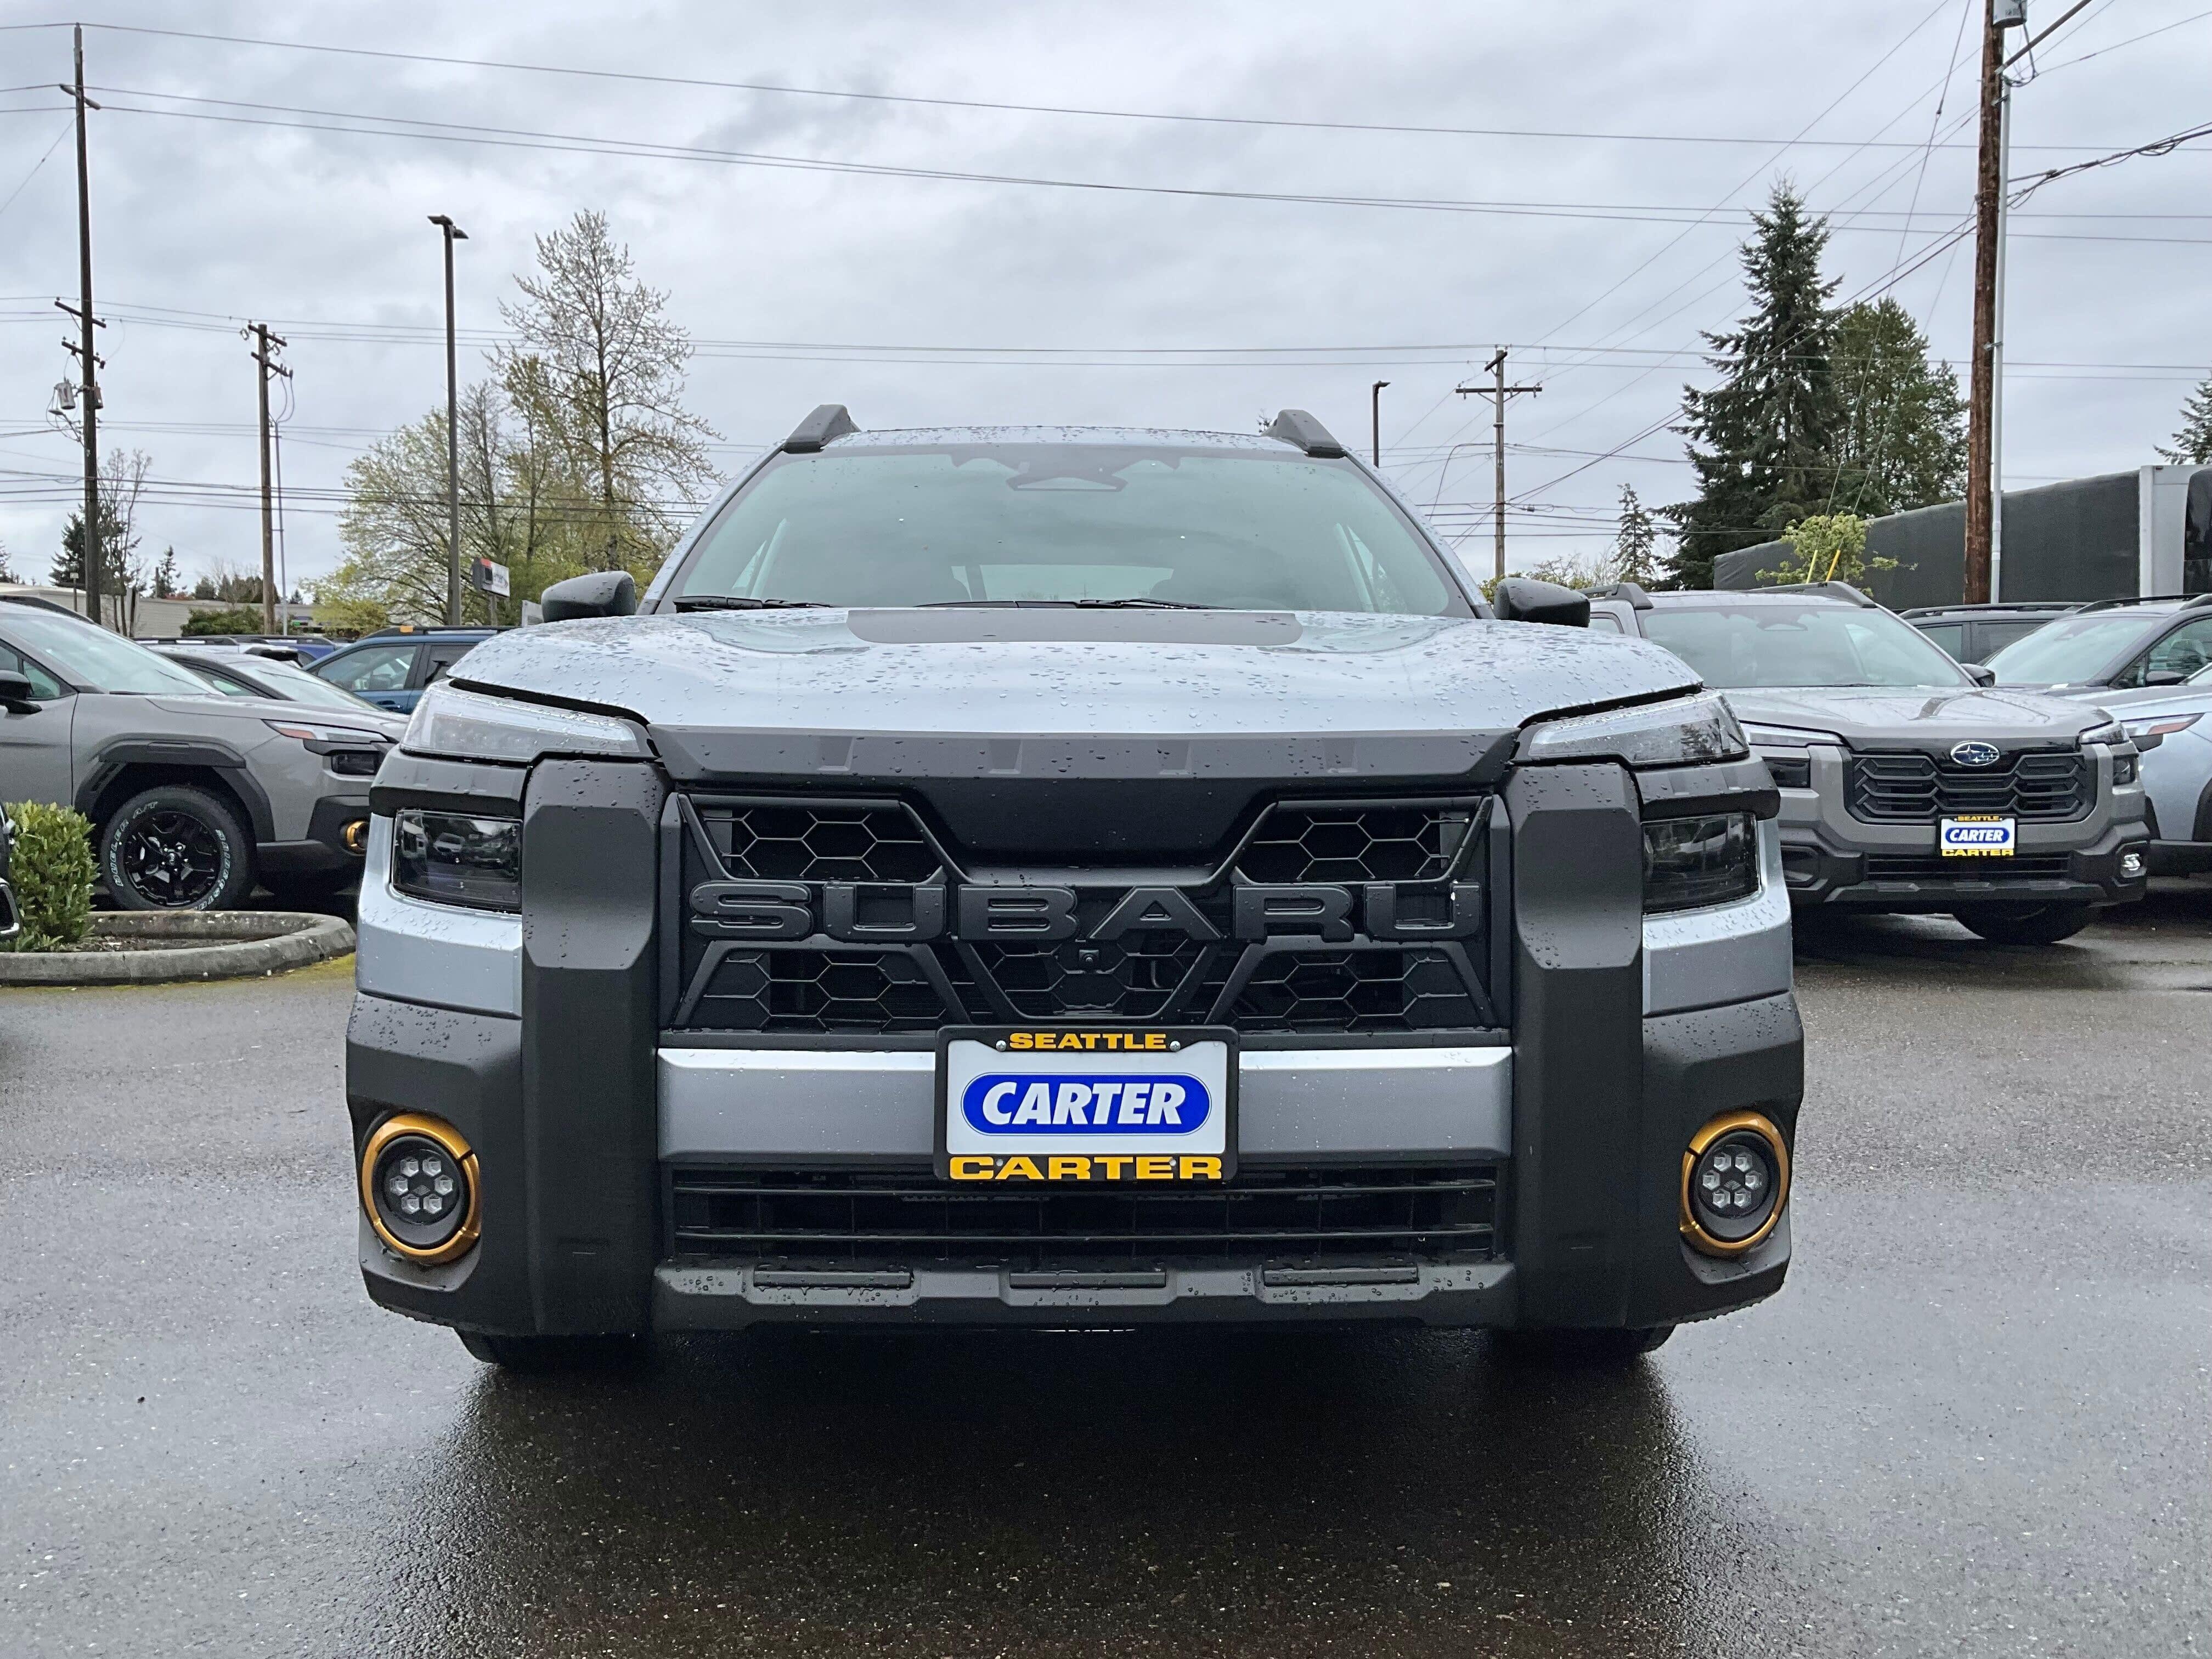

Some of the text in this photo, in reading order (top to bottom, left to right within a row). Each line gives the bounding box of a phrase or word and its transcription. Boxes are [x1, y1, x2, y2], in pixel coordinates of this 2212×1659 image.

[110, 801, 159, 887] DUELER A/T
[1949, 829, 2004, 842] CARTER
[689, 881, 1481, 943] SUBARU
[1009, 1032, 1166, 1050] SEATTLE
[982, 1081, 1186, 1126] CARTER
[949, 1155, 1222, 1181] CARTER
